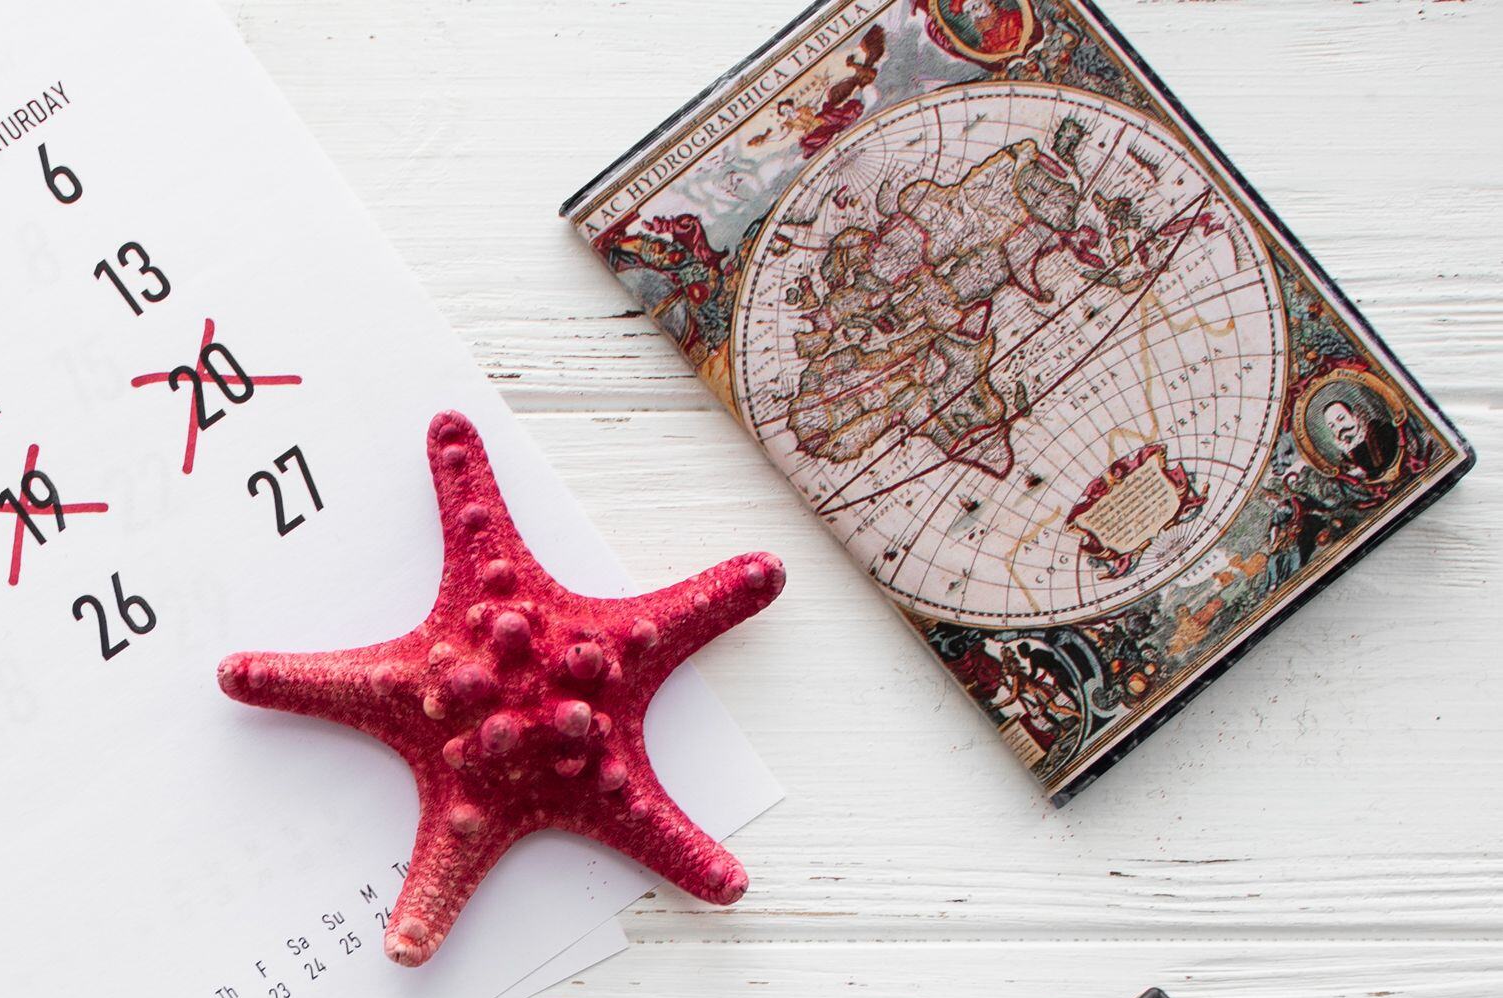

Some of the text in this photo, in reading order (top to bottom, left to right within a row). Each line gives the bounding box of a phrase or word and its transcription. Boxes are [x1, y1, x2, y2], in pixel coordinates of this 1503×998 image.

[38, 143, 82, 203] 6
[601, 197, 623, 221] AC
[627, 67, 790, 202] HYDROGRAPHICA
[94, 242, 171, 316] 13
[168, 343, 254, 431] 20
[72, 572, 156, 661] 26
[248, 445, 323, 536] 27
[254, 959, 267, 979] F
[286, 936, 311, 956] Sa
[321, 910, 346, 931] Su
[359, 883, 379, 905] M
[303, 957, 327, 979] 24
[338, 931, 362, 954] 25
